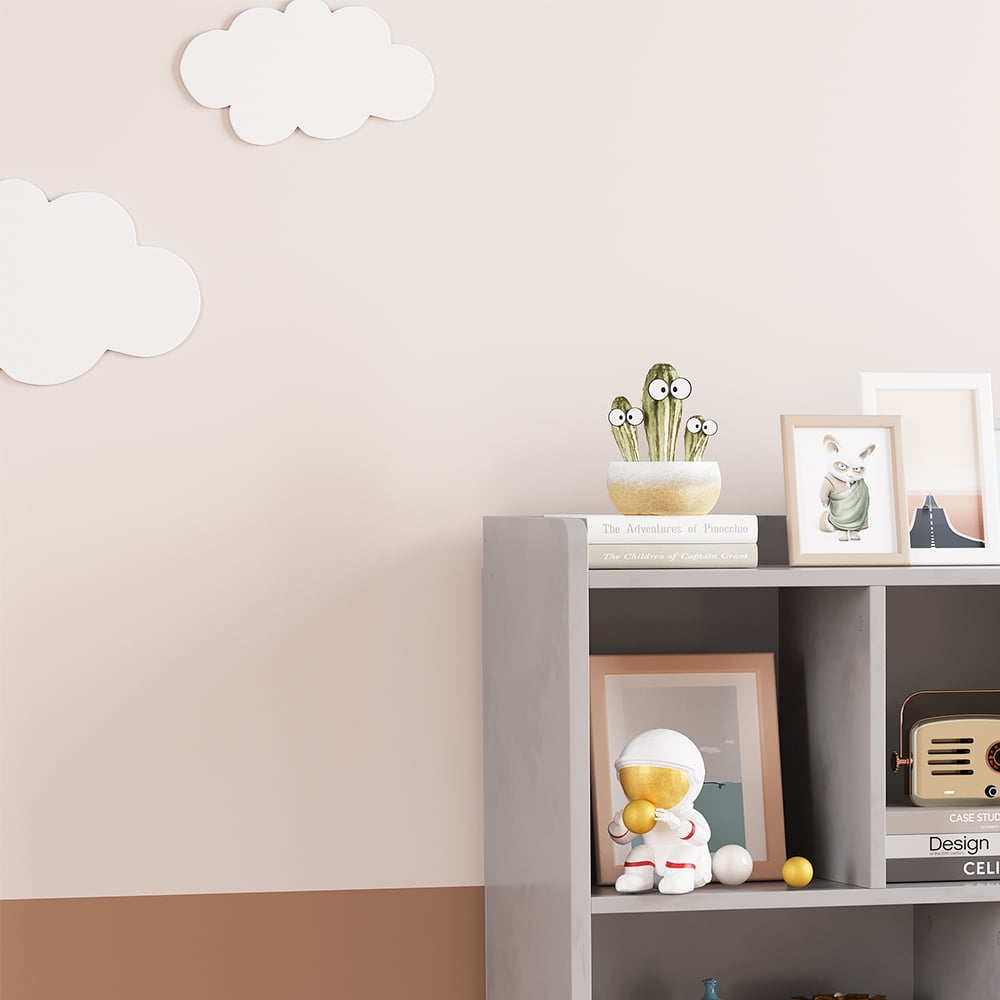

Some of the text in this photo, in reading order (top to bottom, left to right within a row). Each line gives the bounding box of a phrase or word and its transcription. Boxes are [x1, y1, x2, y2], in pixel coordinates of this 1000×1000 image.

[603, 523, 749, 534] The Adventures of Pinocchio
[603, 552, 749, 562] The Children of Captain Grant
[949, 813, 975, 823] CASE
[929, 835, 990, 855] Design
